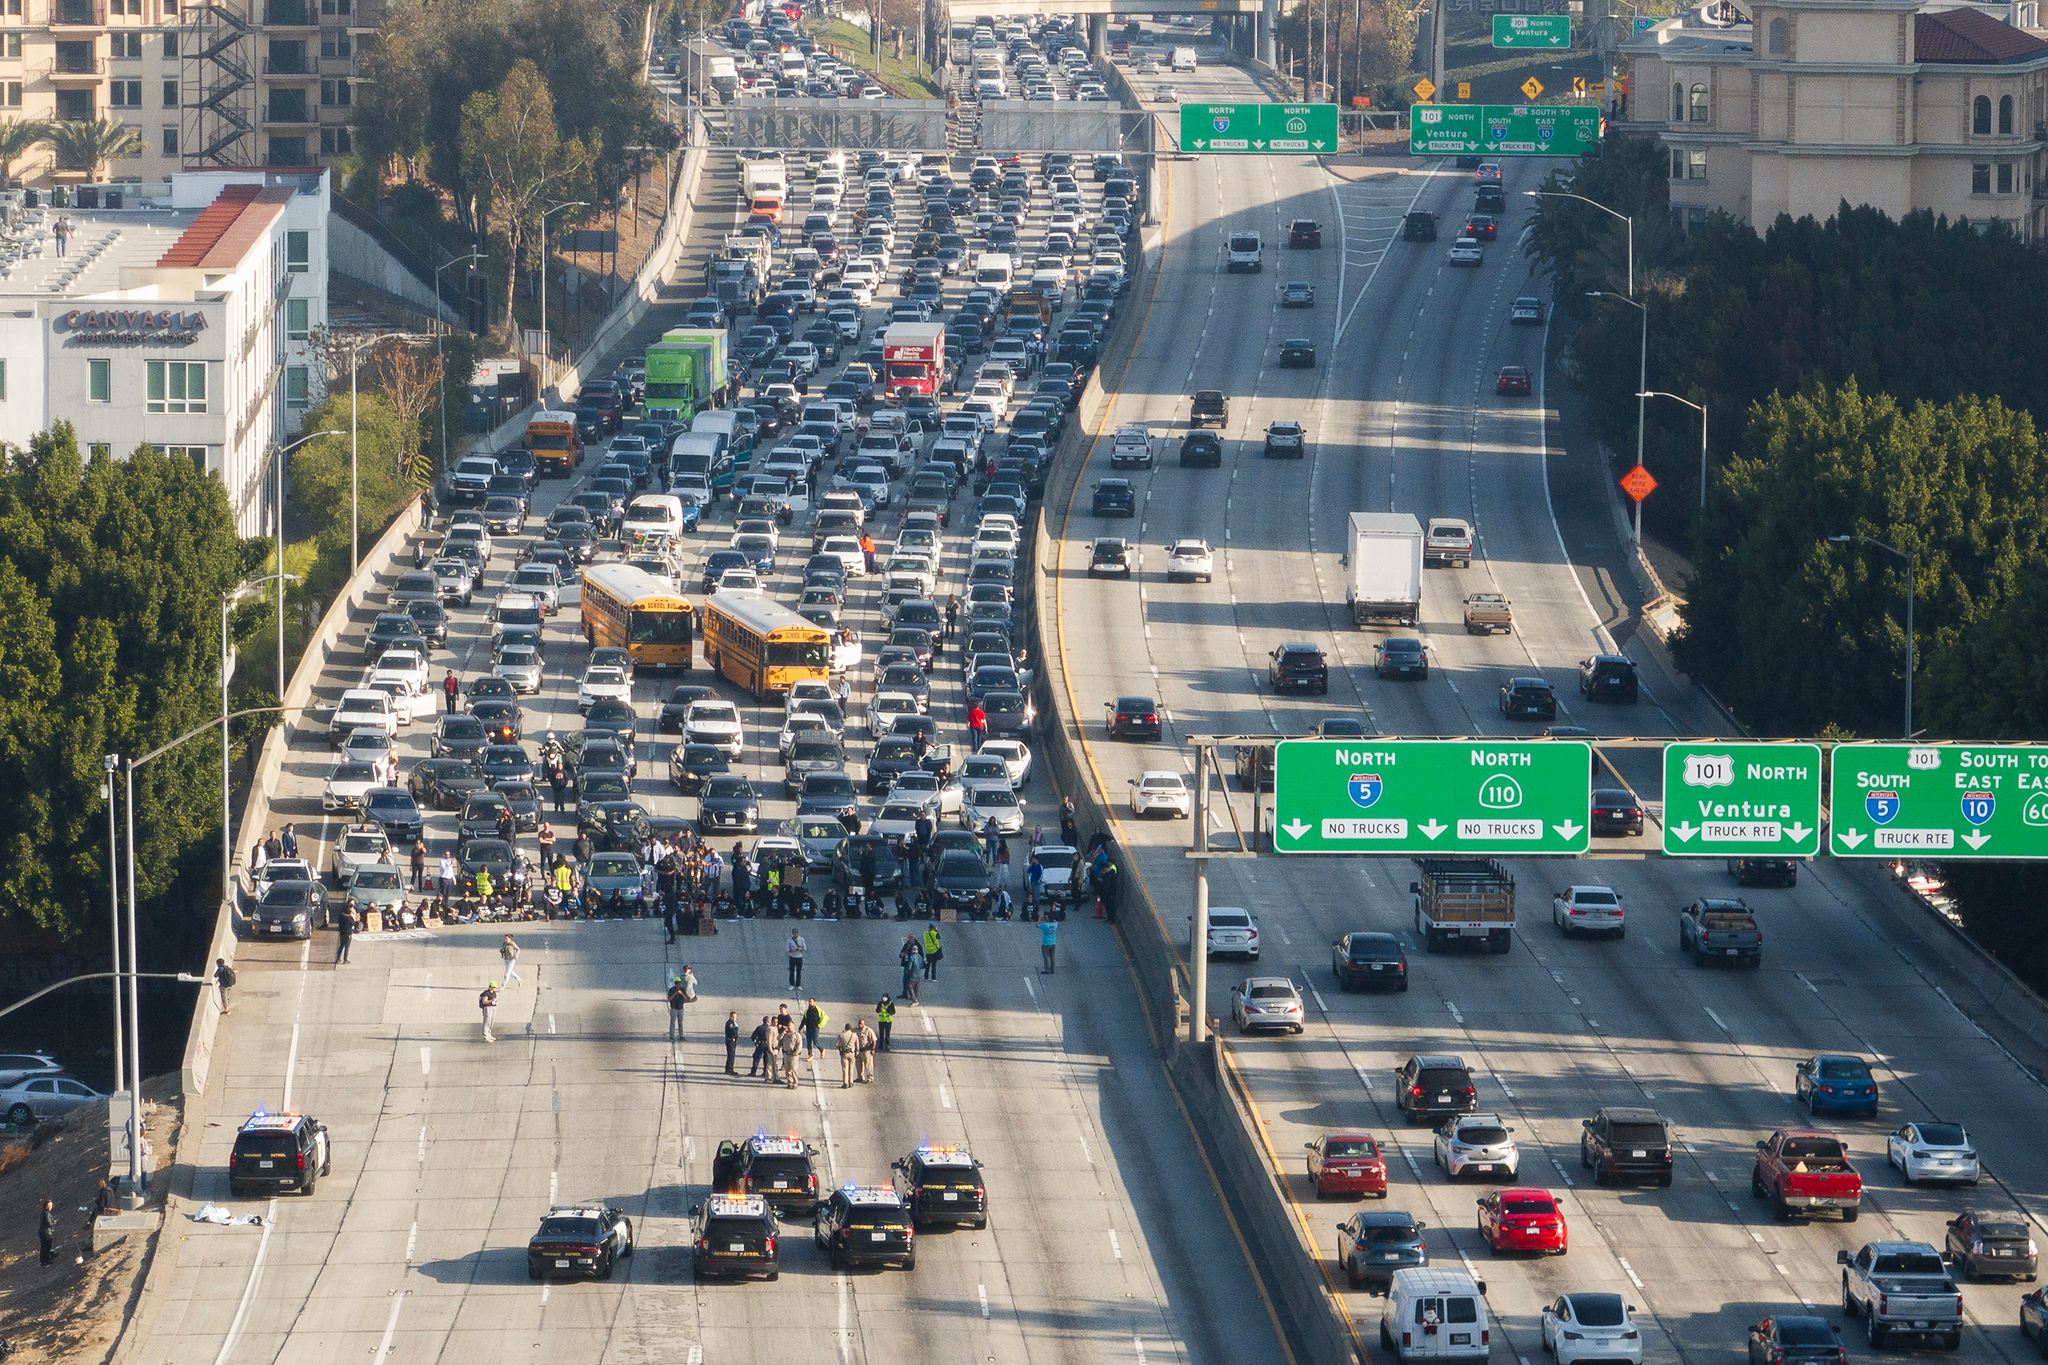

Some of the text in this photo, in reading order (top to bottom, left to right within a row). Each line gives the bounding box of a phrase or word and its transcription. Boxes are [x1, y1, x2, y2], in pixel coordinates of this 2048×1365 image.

[1284, 107, 1310, 115] NORTH
[1424, 113, 1439, 121] 101
[1218, 121, 1224, 129] 5
[1290, 122, 1302, 130] 110
[1426, 129, 1468, 138] Ventura
[66, 310, 209, 329] CANVAS LA
[77, 333, 198, 344] APARTMENT HOMES
[1336, 749, 1396, 765] NORTH
[1471, 750, 1531, 766] NORTH
[1915, 751, 2048, 768] 101 SOUTH TO
[1696, 764, 1807, 780] 101 NORTH
[1857, 772, 1910, 788] SOUTH
[1955, 773, 2002, 788] EAST
[1360, 784, 1371, 800] 5
[1489, 786, 1515, 803] 110
[1698, 800, 1790, 818] Ventura
[1877, 801, 1888, 816] 5
[1970, 801, 1988, 818] 10
[1329, 823, 1400, 834] NO TRUCKS
[1464, 824, 1536, 835] NO TRUCKS
[1708, 826, 1776, 837] TRUCK RTE
[1880, 834, 1948, 844] TRUCK RTE
